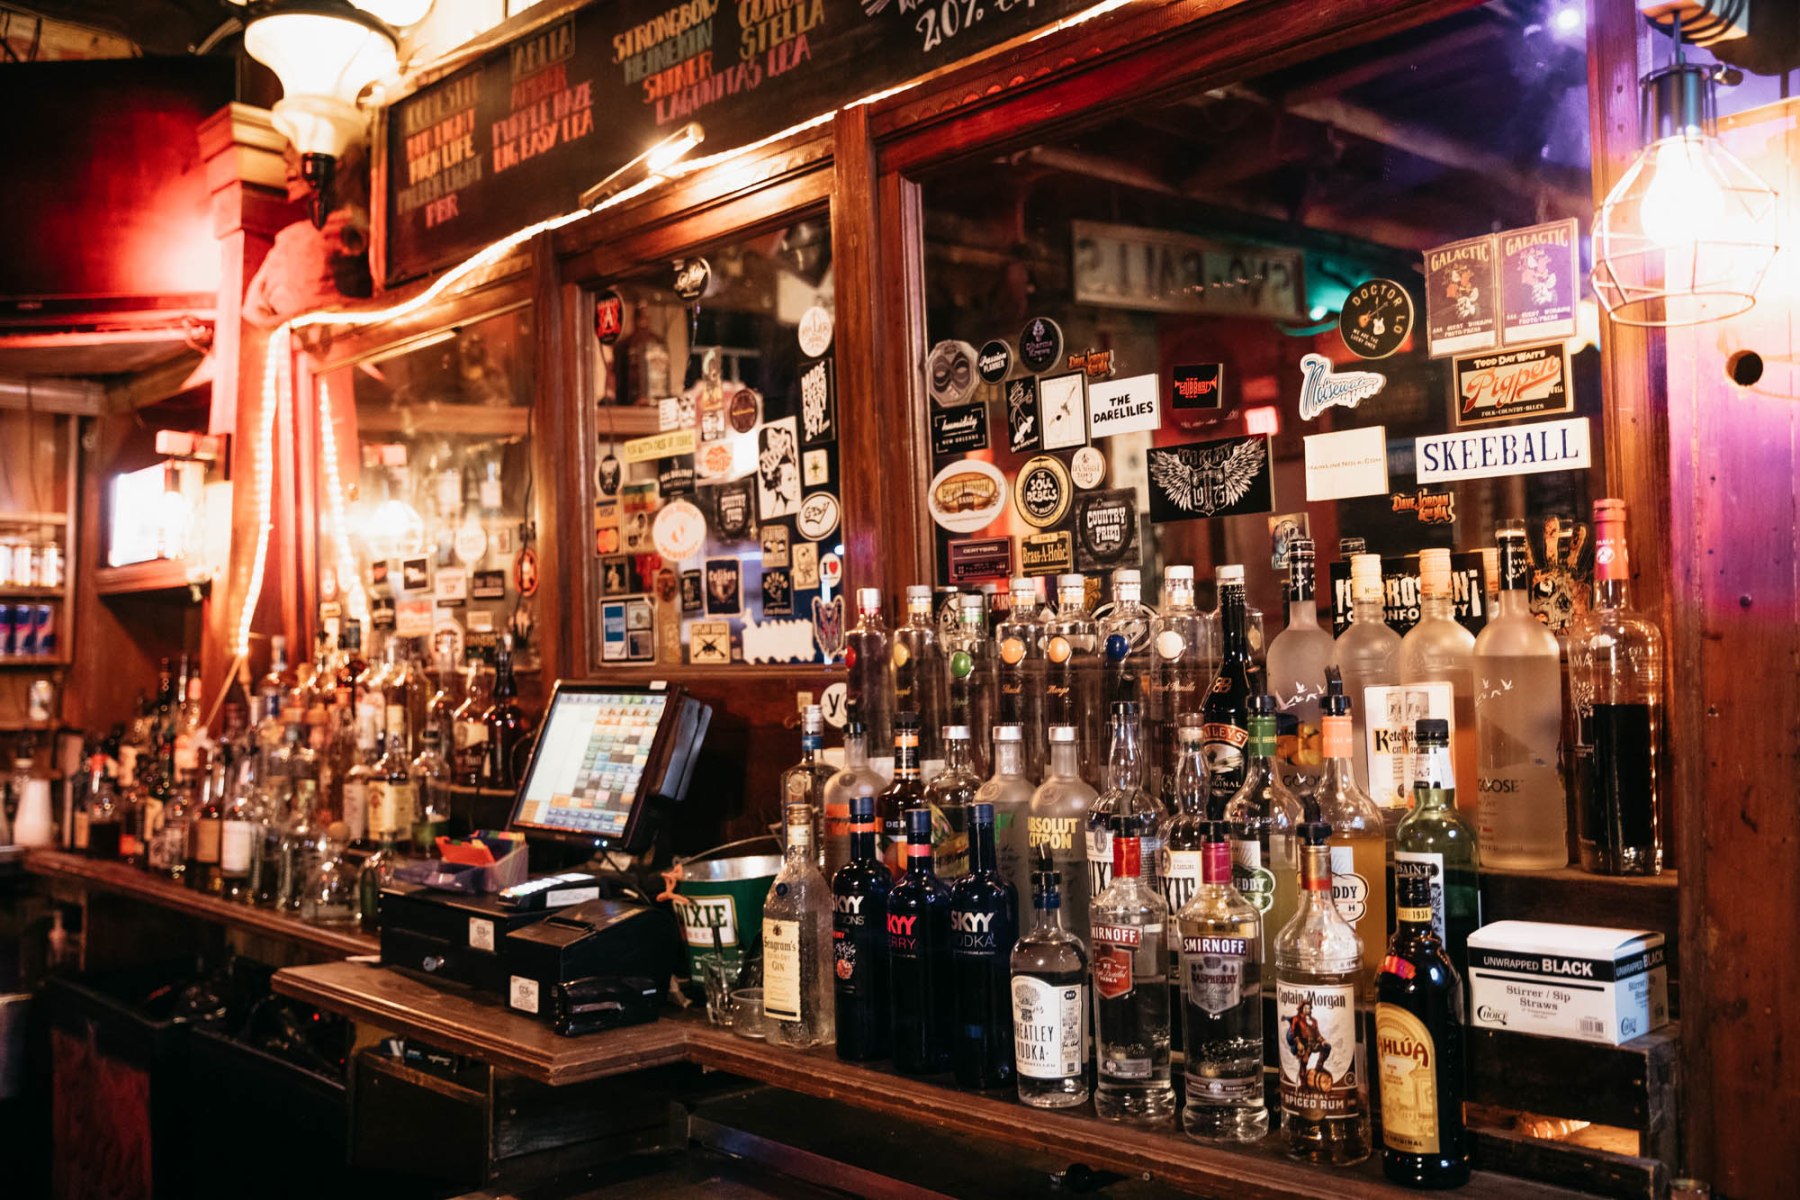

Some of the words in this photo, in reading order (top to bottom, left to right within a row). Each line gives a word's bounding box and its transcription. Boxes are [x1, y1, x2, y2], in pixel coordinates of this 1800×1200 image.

[740, 0, 824, 61] STELLA
[916, 0, 984, 52] 20%
[1505, 229, 1569, 257] GALACTIC
[1431, 243, 1489, 273] GALACTIC
[1352, 284, 1402, 308] DOCTOR
[1498, 354, 1516, 365] DAY
[1462, 355, 1563, 413] Pigpen
[1109, 394, 1131, 407] THE
[1093, 401, 1154, 424] DARELILIES
[1423, 428, 1579, 472] SKEEBALL
[1030, 478, 1054, 491] SOUL
[1026, 488, 1058, 503] REBELS
[1087, 506, 1126, 529] COUNTRY
[1095, 524, 1121, 544] FRIED
[1029, 832, 1072, 850] CITRON
[1332, 885, 1358, 899] DDY
[951, 910, 995, 933] SKYY
[764, 936, 797, 952] Seagram's
[1483, 956, 1539, 971] UNWRAPPED
[1541, 957, 1594, 978] BLACK
[1305, 990, 1346, 1009] Morgan
[1506, 984, 1544, 998] Stirrer
[1552, 990, 1571, 1003] Sip
[1519, 996, 1559, 1011] Straws
[1320, 1099, 1344, 1110] RUM
